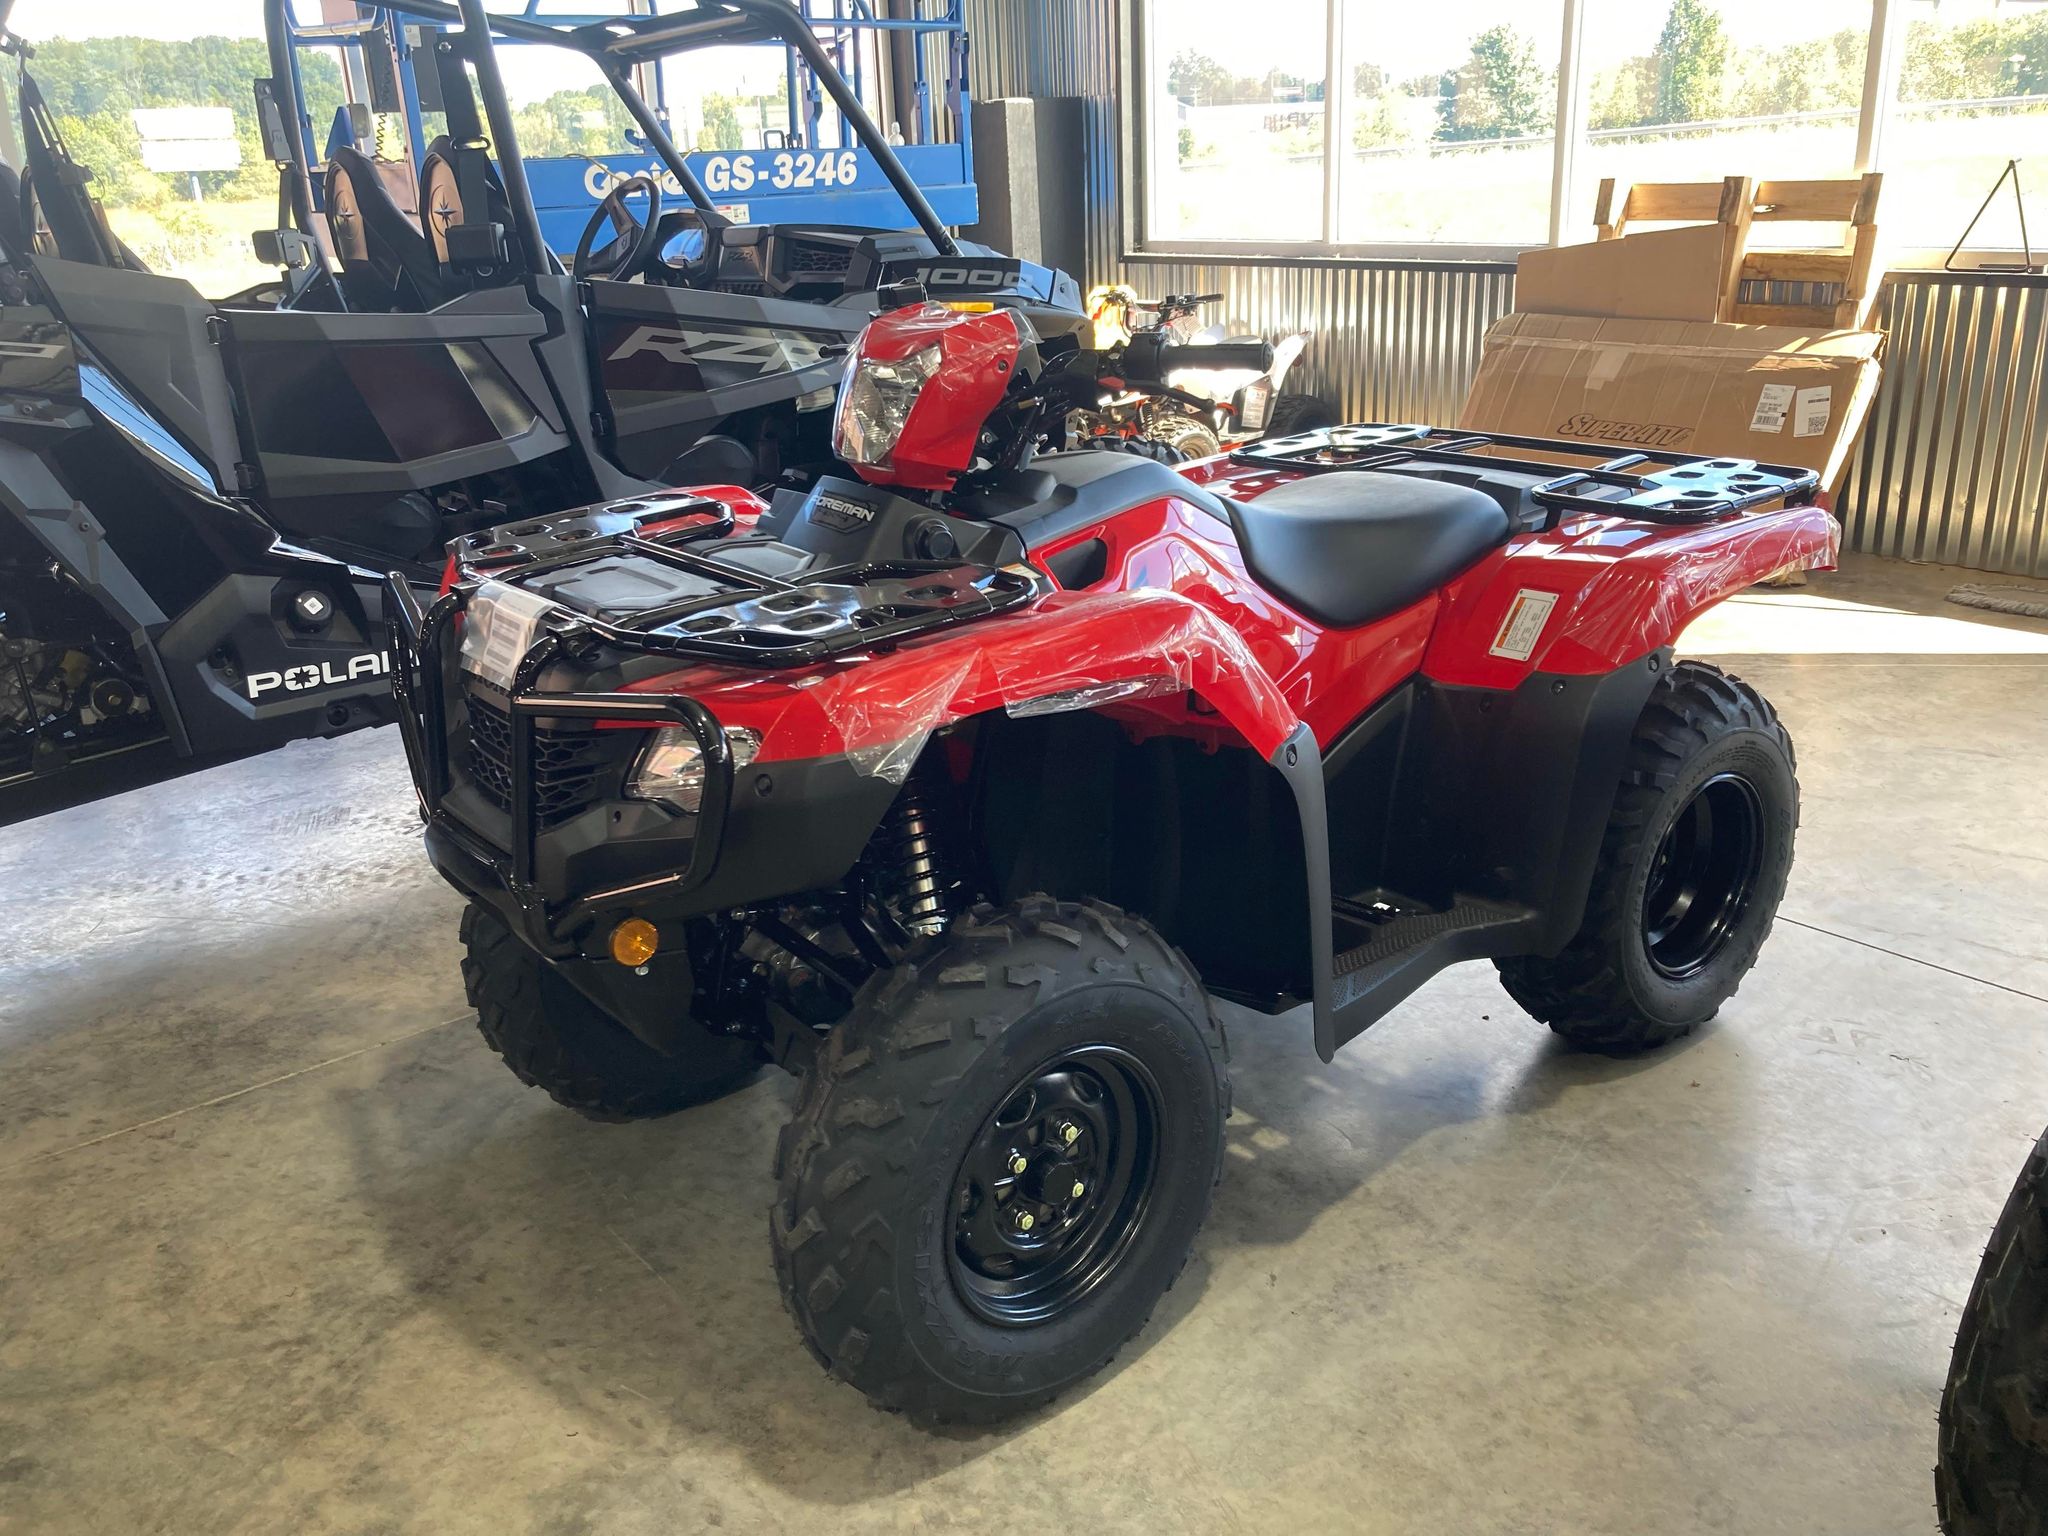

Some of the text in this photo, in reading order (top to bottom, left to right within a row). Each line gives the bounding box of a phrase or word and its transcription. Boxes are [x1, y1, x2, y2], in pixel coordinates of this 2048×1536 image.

[705, 152, 858, 192] GS-3246
[606, 325, 830, 376] RZR
[811, 494, 875, 522] FOREMAN
